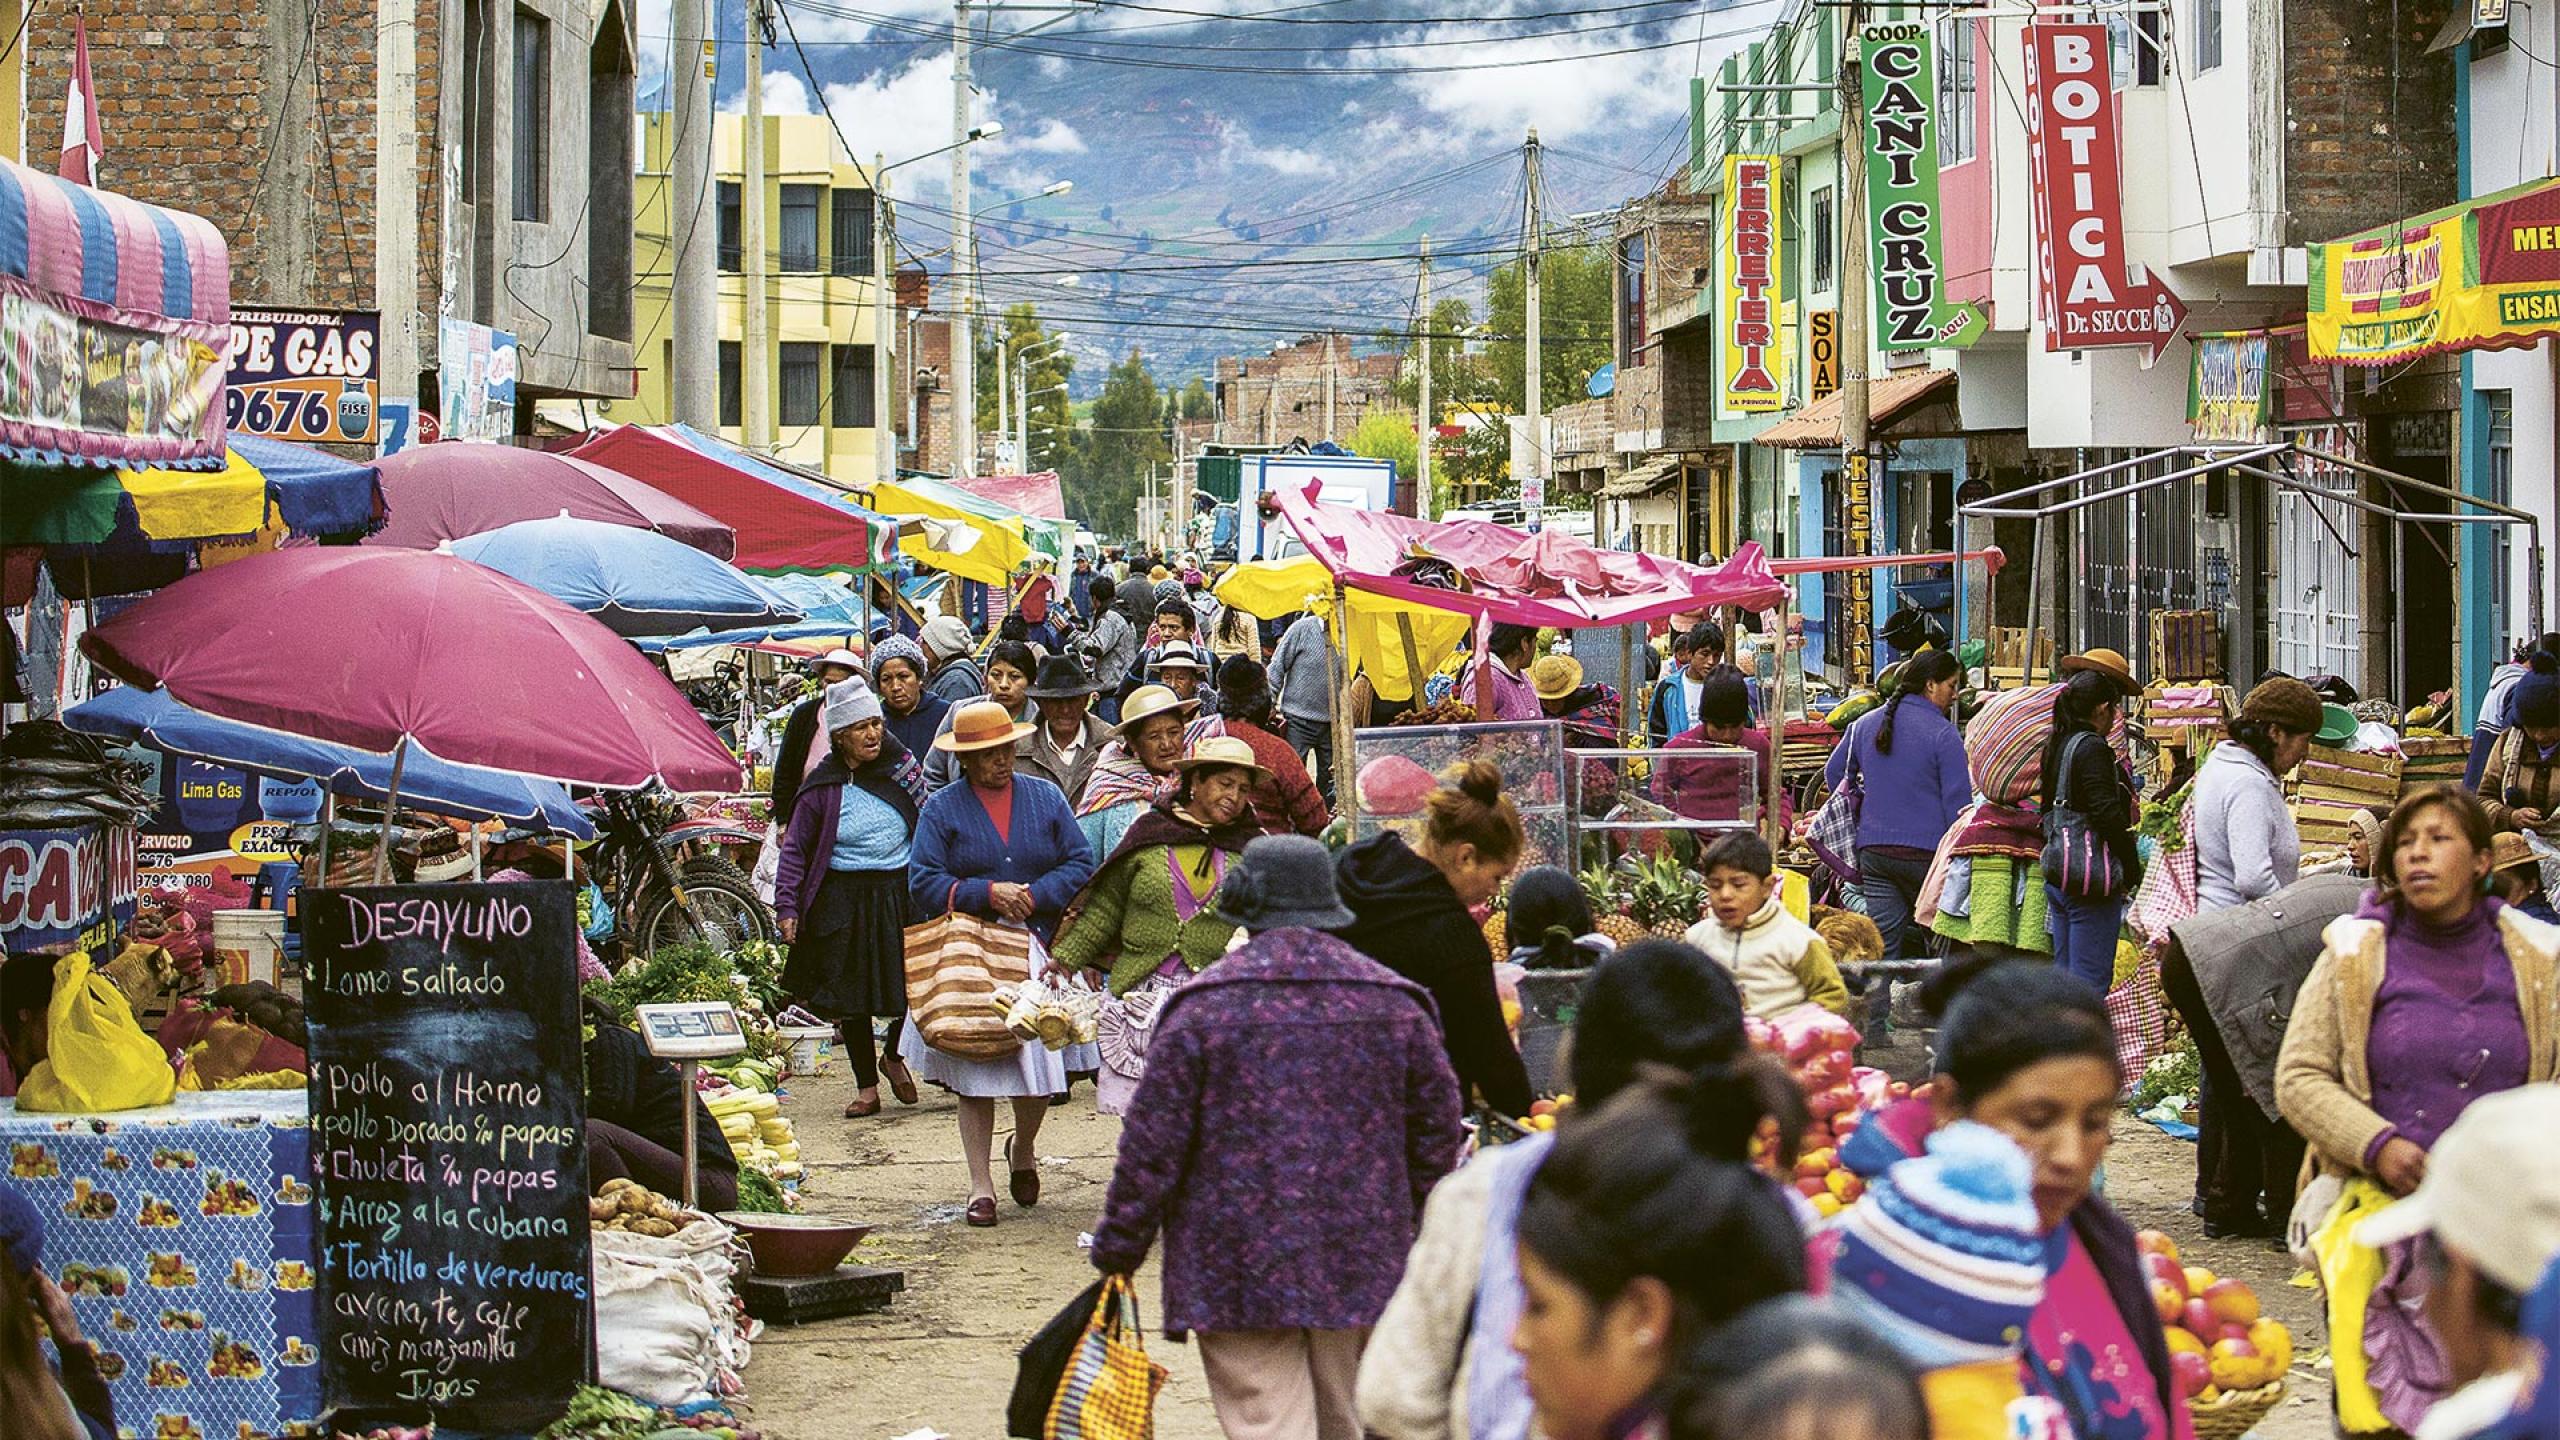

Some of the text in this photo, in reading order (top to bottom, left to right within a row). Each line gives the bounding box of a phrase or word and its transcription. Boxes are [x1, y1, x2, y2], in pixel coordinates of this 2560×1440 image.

[1864, 24, 1925, 42] COOP.
[1870, 44, 1929, 188] CANI
[2025, 43, 2057, 333] BOTICA
[2051, 34, 2116, 305] BOTICA
[1733, 164, 1774, 392] FERRETERIA
[1878, 203, 1938, 345] CRUZ
[2065, 308, 2152, 334] Dr. SECCE
[2504, 294, 2560, 321] ENSA
[285, 327, 373, 376] GAS
[226, 388, 330, 435] 9676
[341, 403, 368, 416] FISE
[182, 780, 242, 800] Lima Gas
[339, 893, 533, 954] DESAYUNO
[324, 958, 391, 996] Lomo
[385, 1114, 467, 1144] Dorado
[500, 1123, 576, 1161] papas
[332, 1143, 426, 1183] Chuleta
[471, 1166, 558, 1205] papas
[338, 1195, 402, 1243] Arroz
[434, 1195, 460, 1229] la
[436, 1251, 468, 1287] de
[395, 1368, 481, 1401] Jugos
